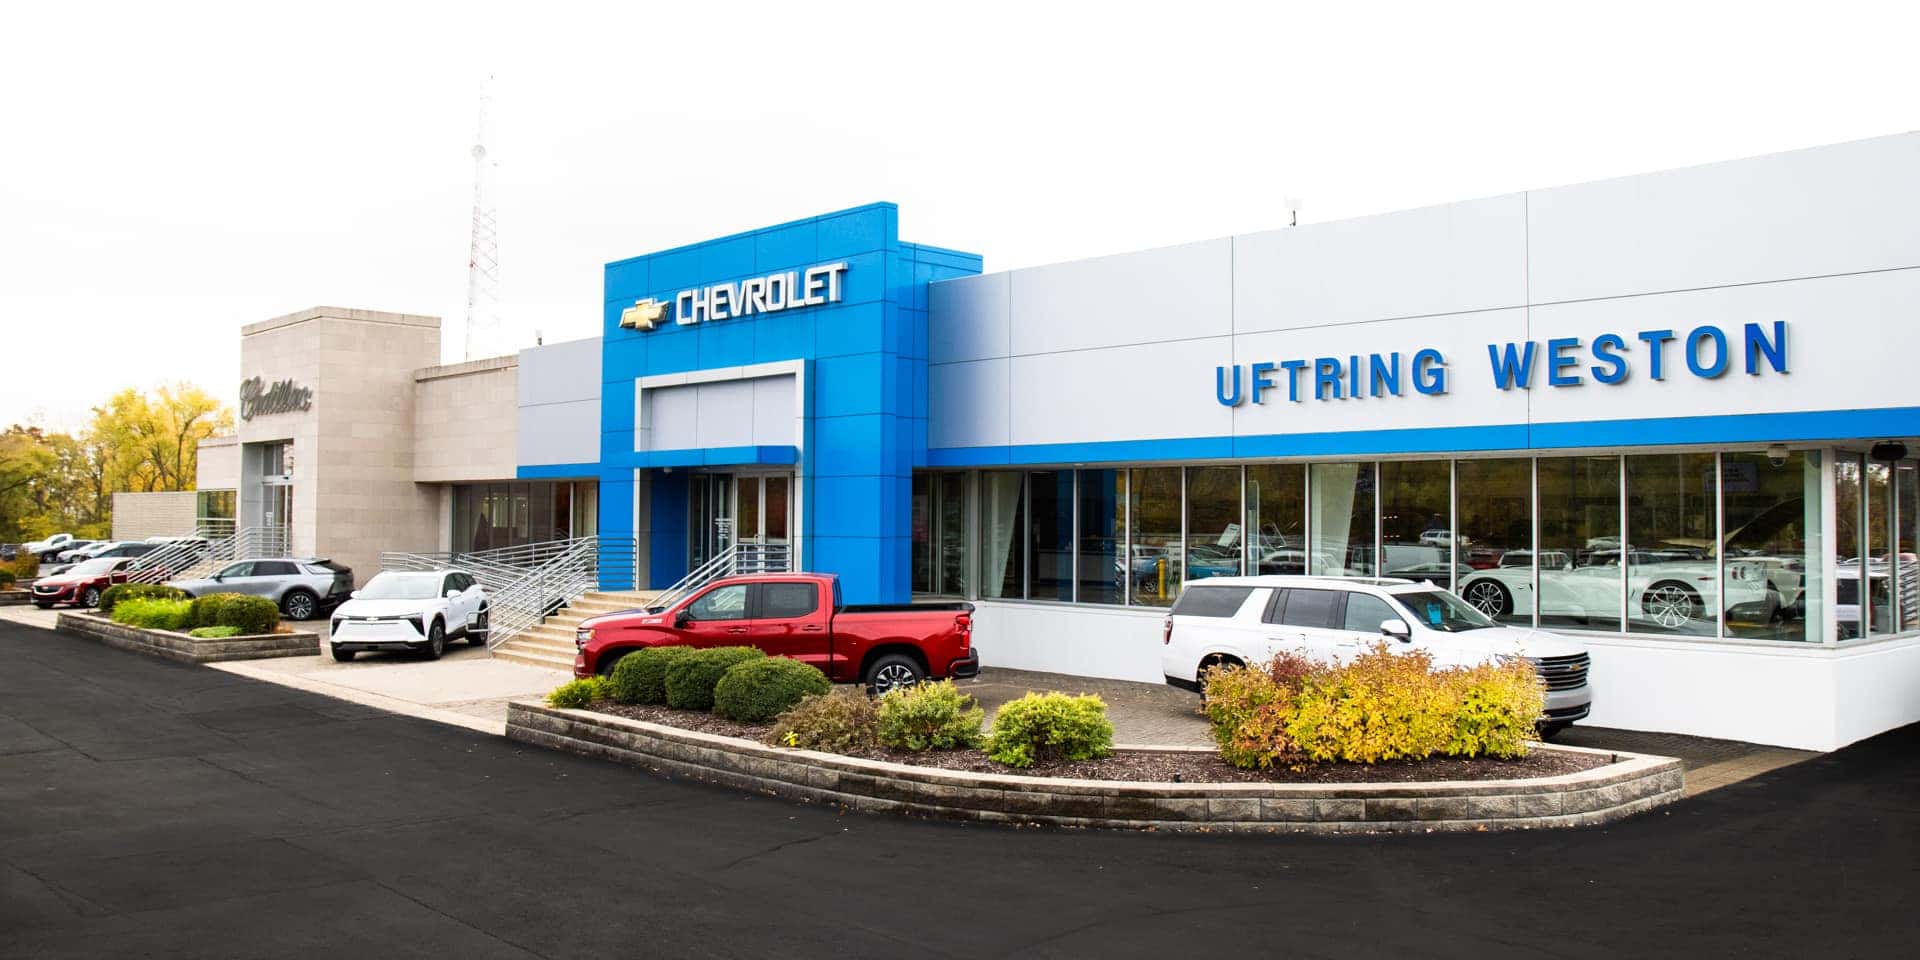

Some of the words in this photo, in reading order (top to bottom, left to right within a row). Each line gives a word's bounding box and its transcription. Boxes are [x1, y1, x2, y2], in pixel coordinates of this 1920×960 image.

[676, 262, 848, 326] CHEVROLET
[1216, 348, 1448, 407] UFTRING
[1488, 320, 1789, 391] WESTON
[240, 376, 313, 422] Cadillac
